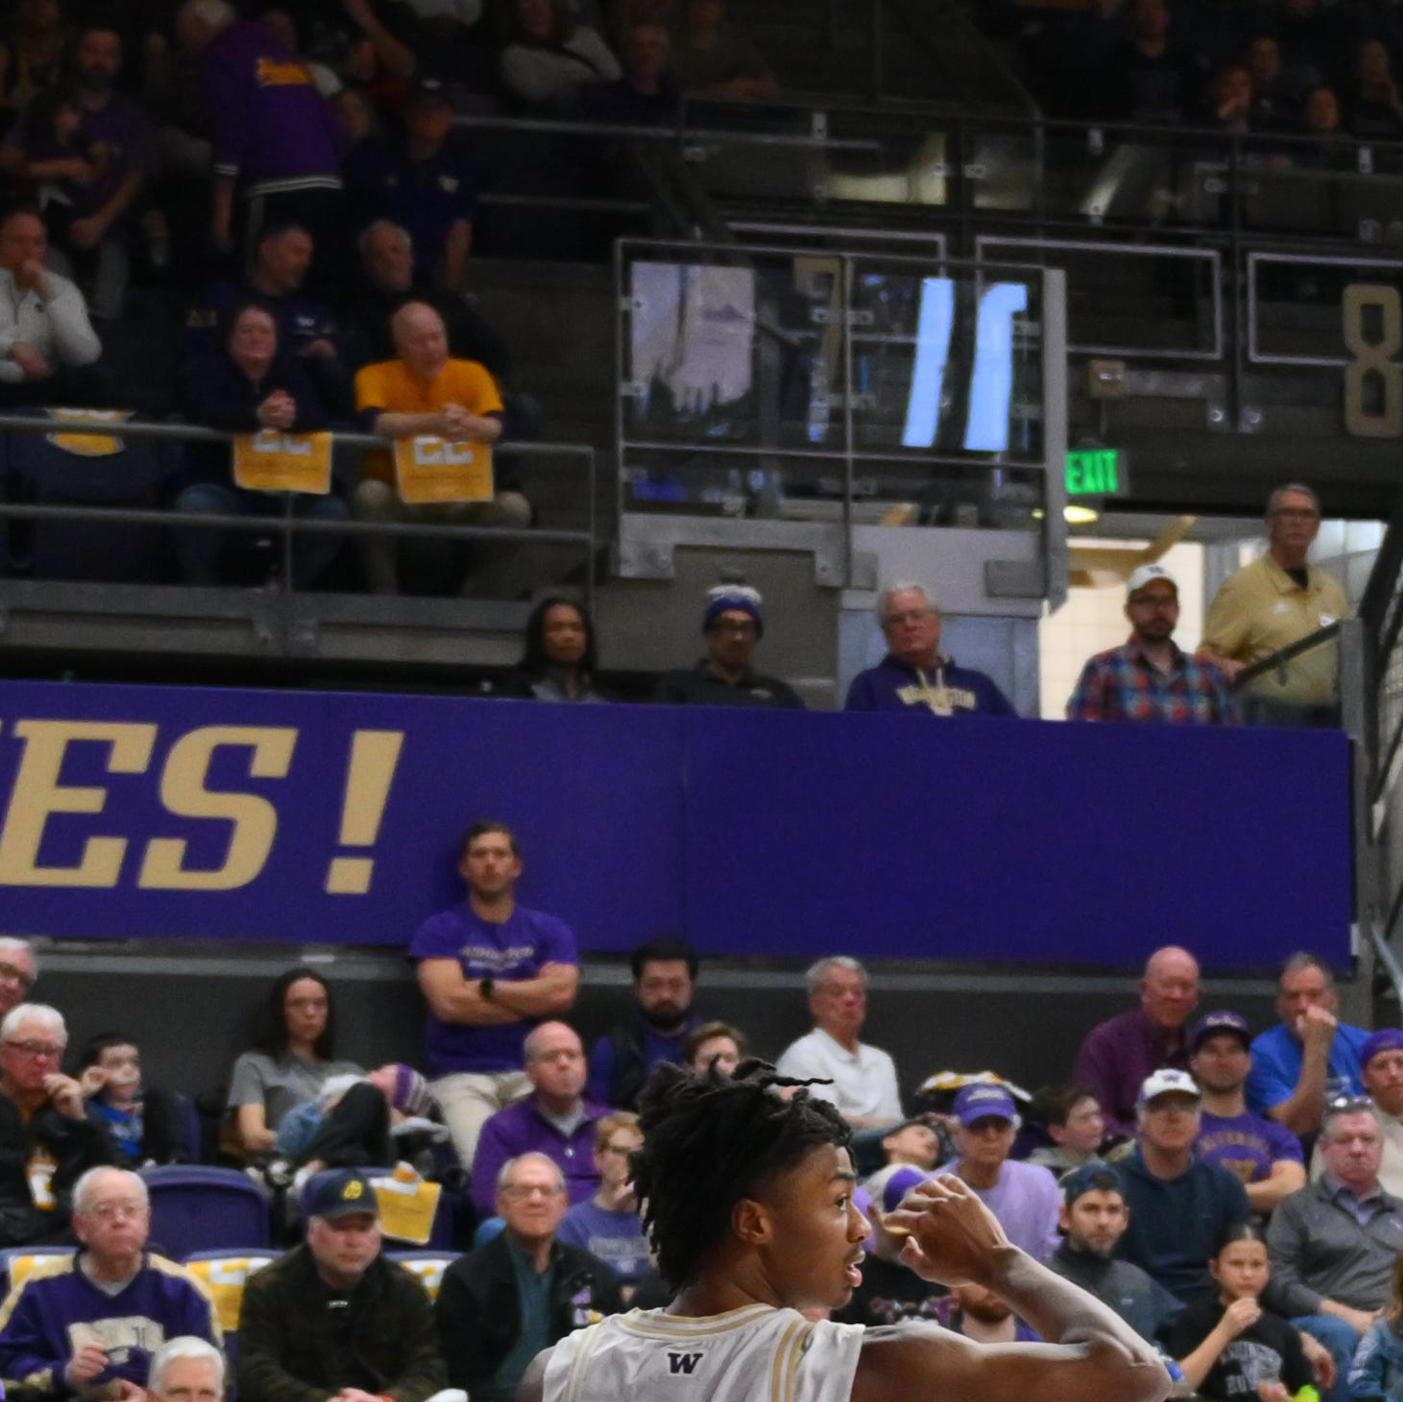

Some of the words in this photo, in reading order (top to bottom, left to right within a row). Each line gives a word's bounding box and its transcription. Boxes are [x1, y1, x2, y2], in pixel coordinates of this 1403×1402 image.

[1341, 285, 1402, 437] 8
[1066, 449, 1118, 494] EXIT
[0, 718, 405, 894] ES!
[667, 1352, 703, 1375] W
